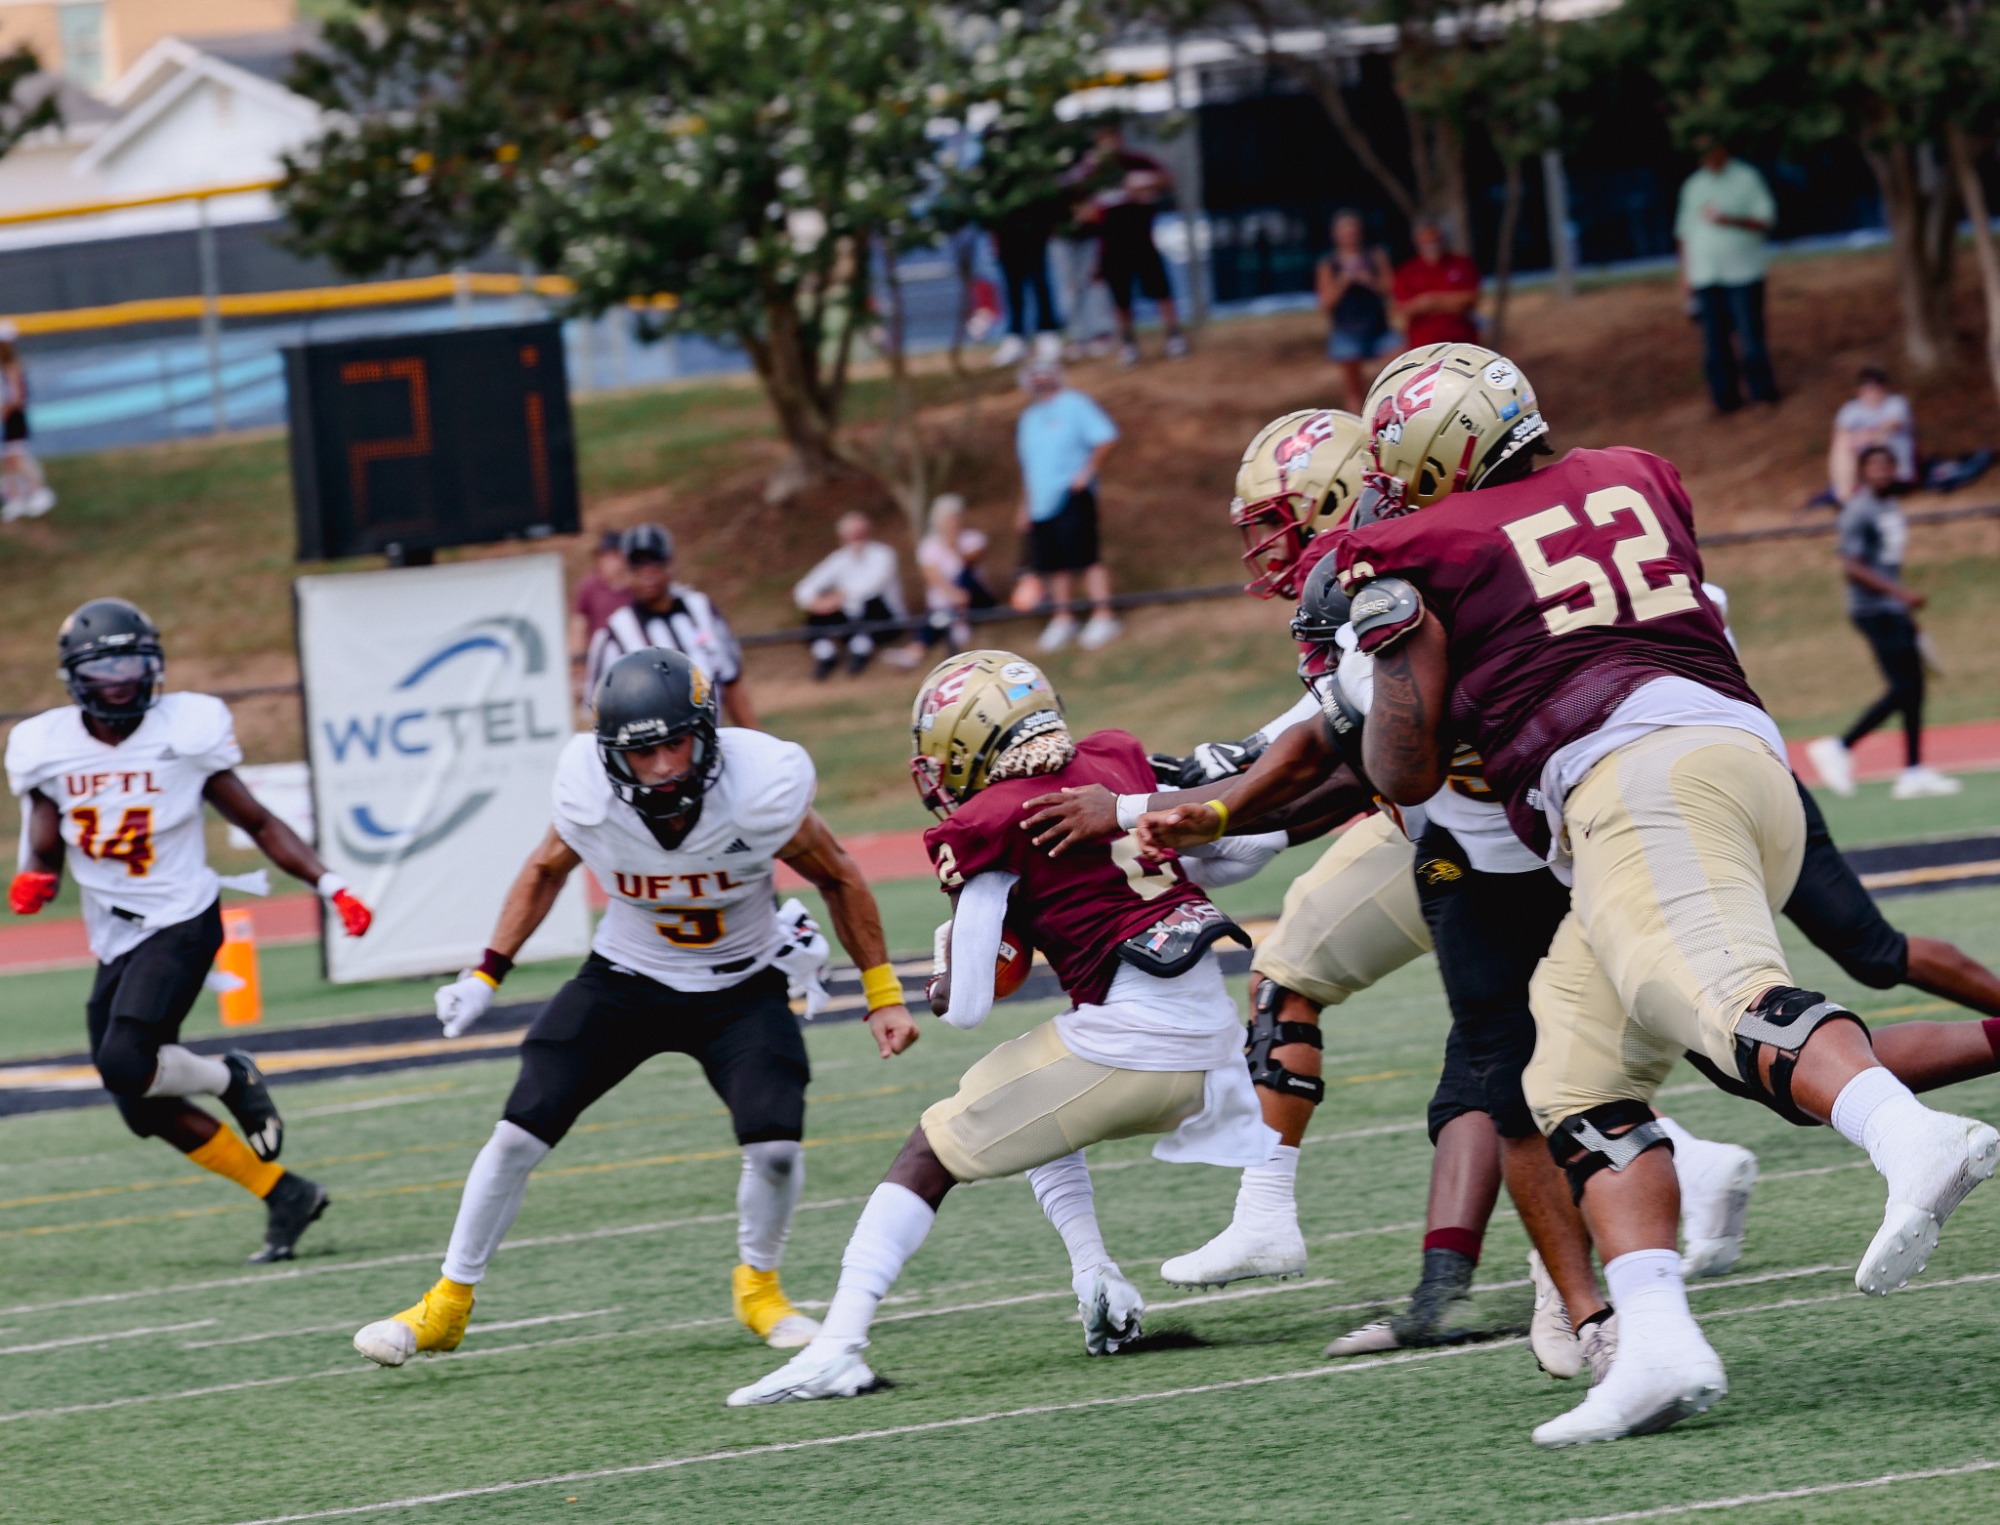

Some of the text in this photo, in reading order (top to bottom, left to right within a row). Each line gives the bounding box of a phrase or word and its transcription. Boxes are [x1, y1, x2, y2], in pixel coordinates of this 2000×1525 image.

[1500, 484, 1701, 637] 52
[322, 698, 561, 763] WCTEL
[66, 772, 163, 796] UFTL
[70, 806, 155, 877] 14
[612, 870, 745, 900] UFTL
[939, 842, 965, 886] 2
[654, 905, 727, 949] 3
